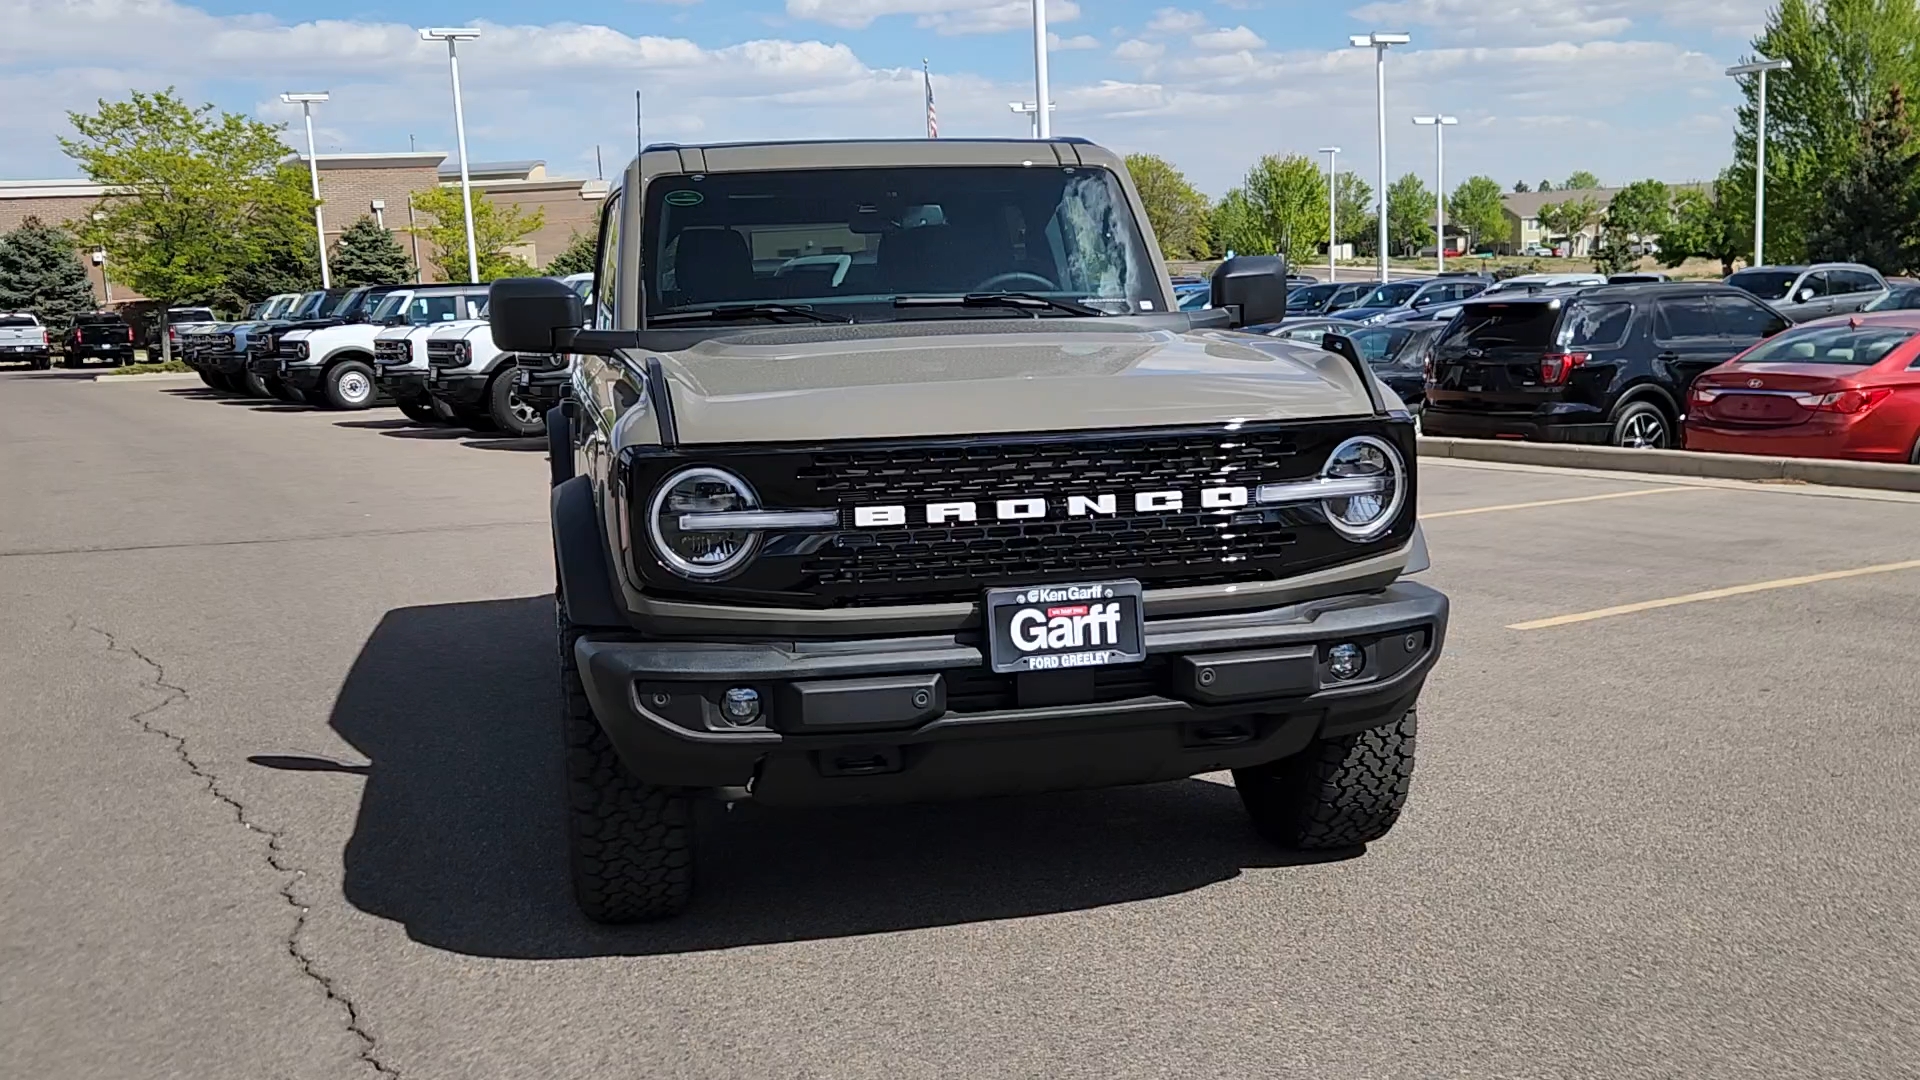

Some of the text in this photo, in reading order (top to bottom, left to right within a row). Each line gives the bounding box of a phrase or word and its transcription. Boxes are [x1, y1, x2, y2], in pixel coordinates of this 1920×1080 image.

[855, 486, 1247, 526] BRONCO
[1040, 586, 1102, 602] Ken Garff
[1010, 603, 1120, 651] Garff
[1029, 652, 1109, 669] FORD GREELEY
